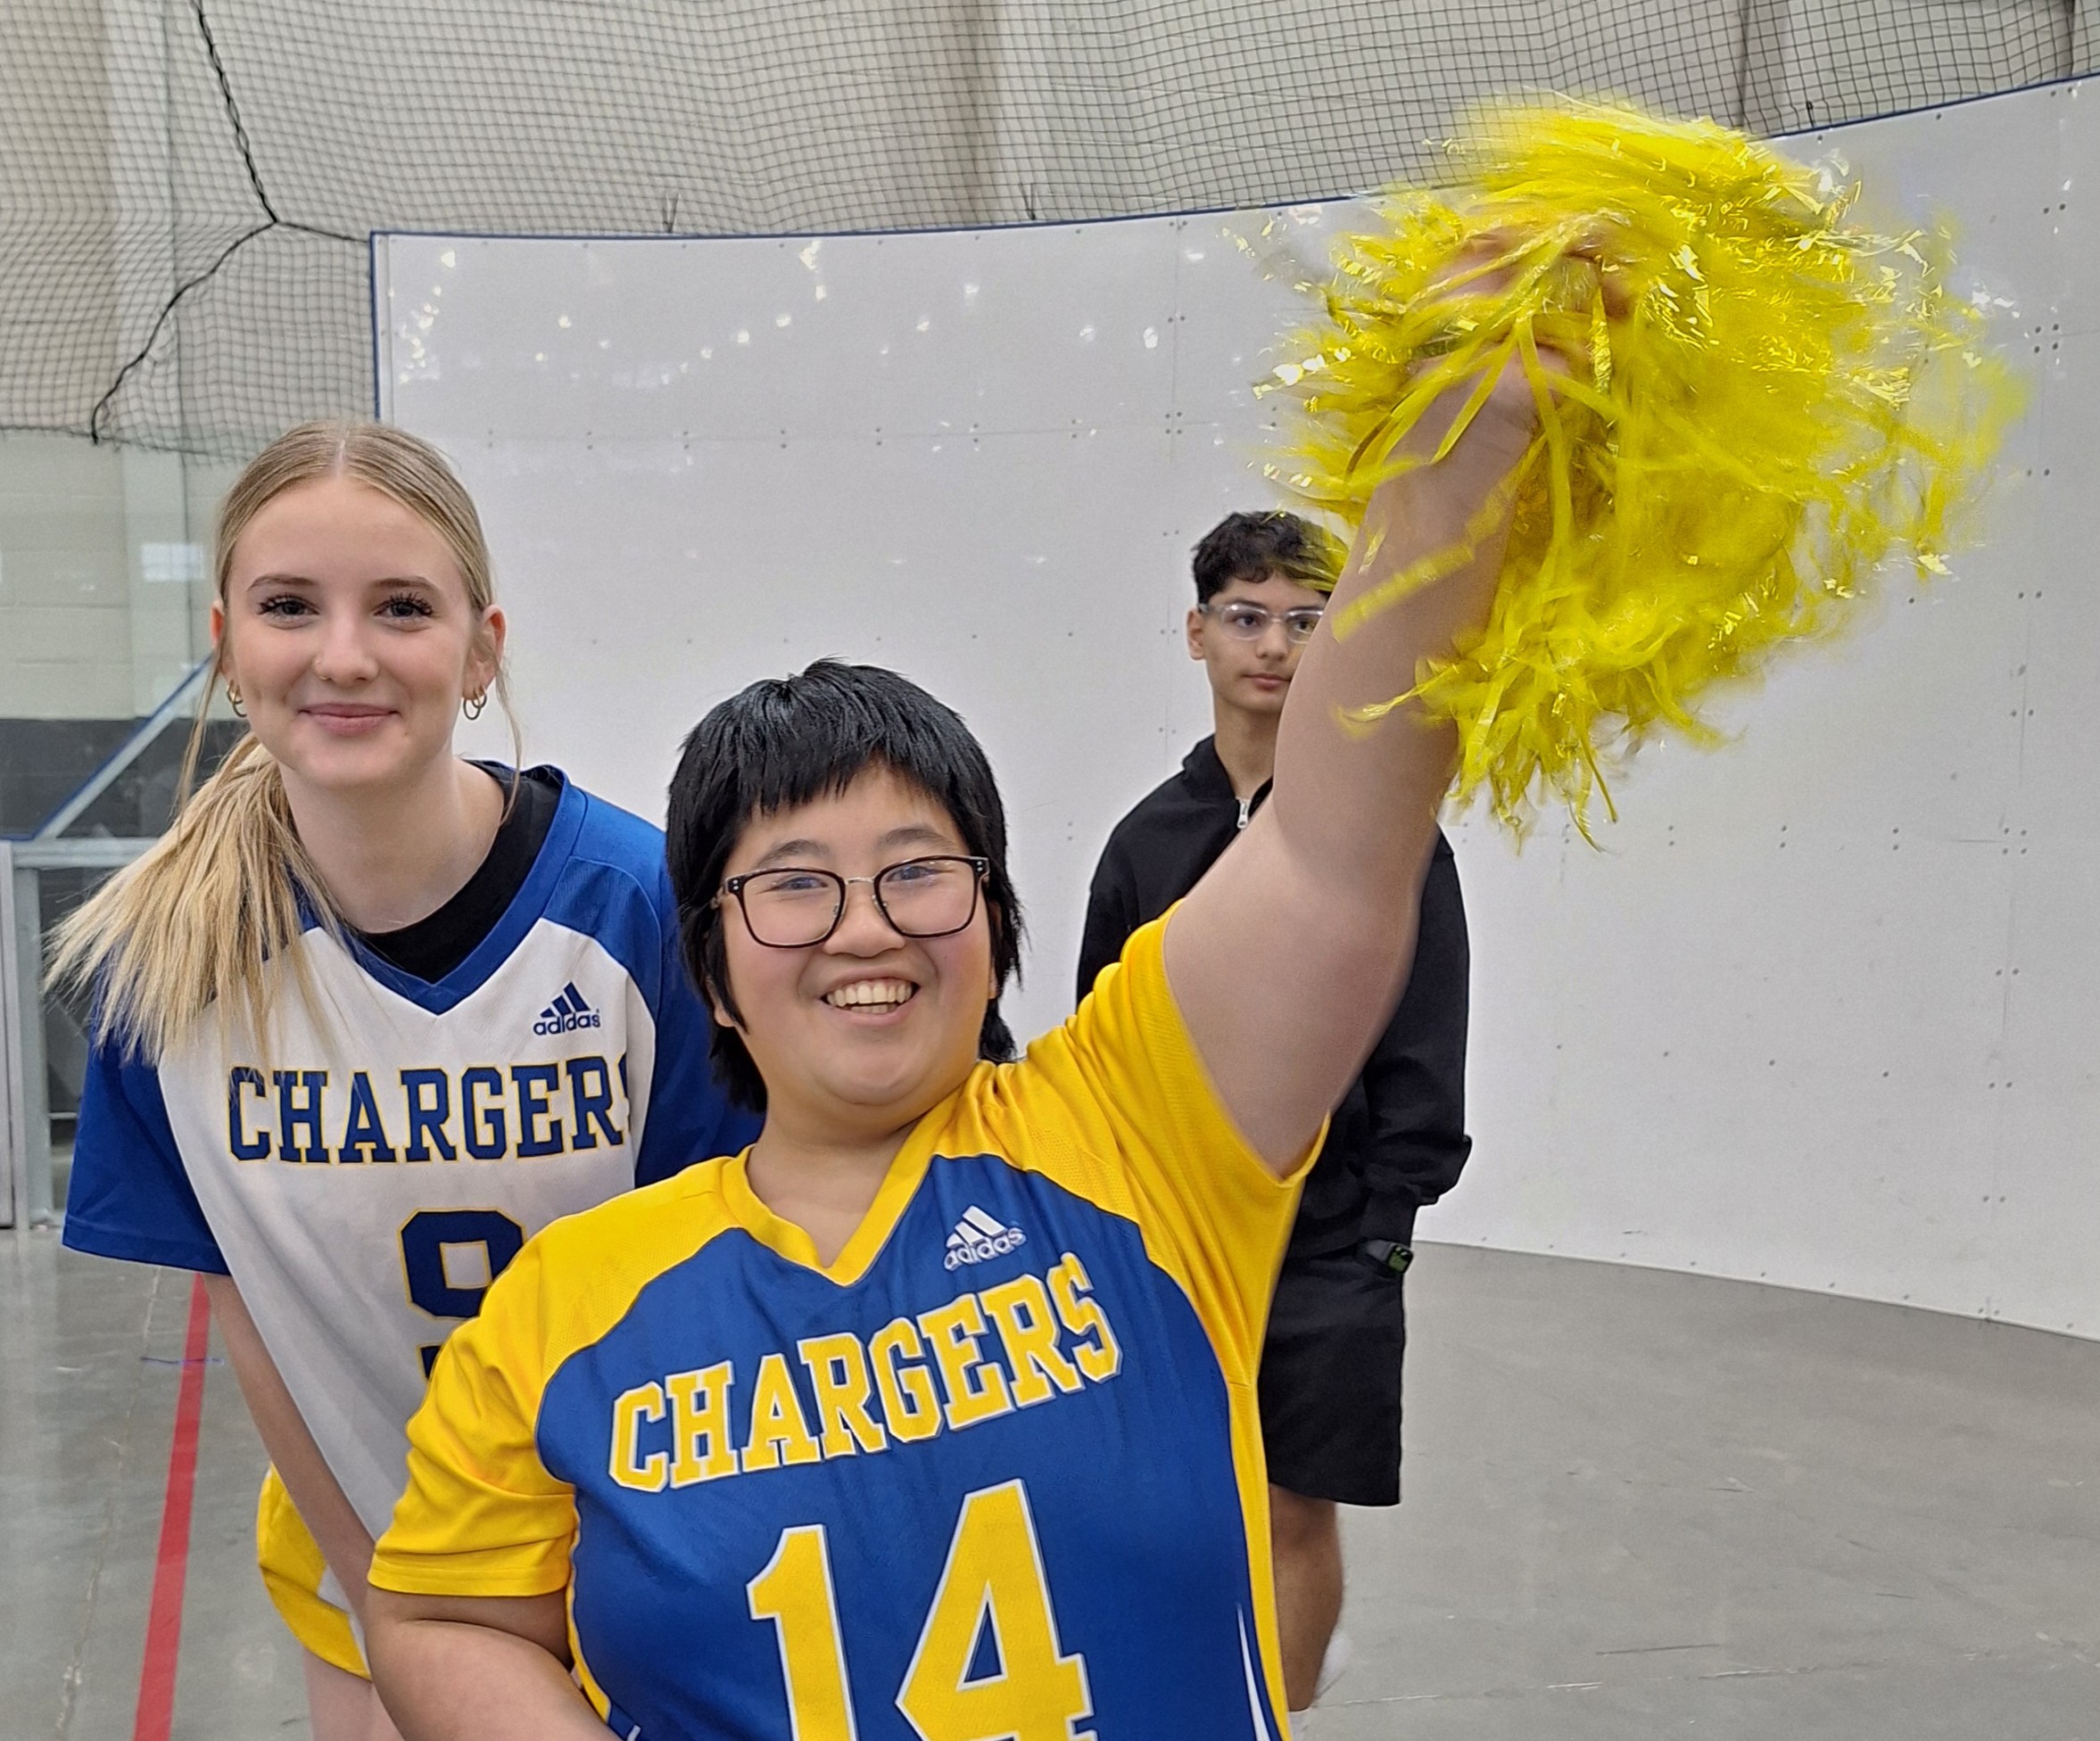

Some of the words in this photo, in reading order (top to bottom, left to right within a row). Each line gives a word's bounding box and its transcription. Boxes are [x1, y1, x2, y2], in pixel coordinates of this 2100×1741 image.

[533, 1011, 600, 1036] adidas
[227, 1052, 631, 1164] CHARGER
[944, 1227, 1027, 1271] adidas
[608, 1251, 1123, 1492] CHARGERS
[745, 1478, 1097, 1741] 14
